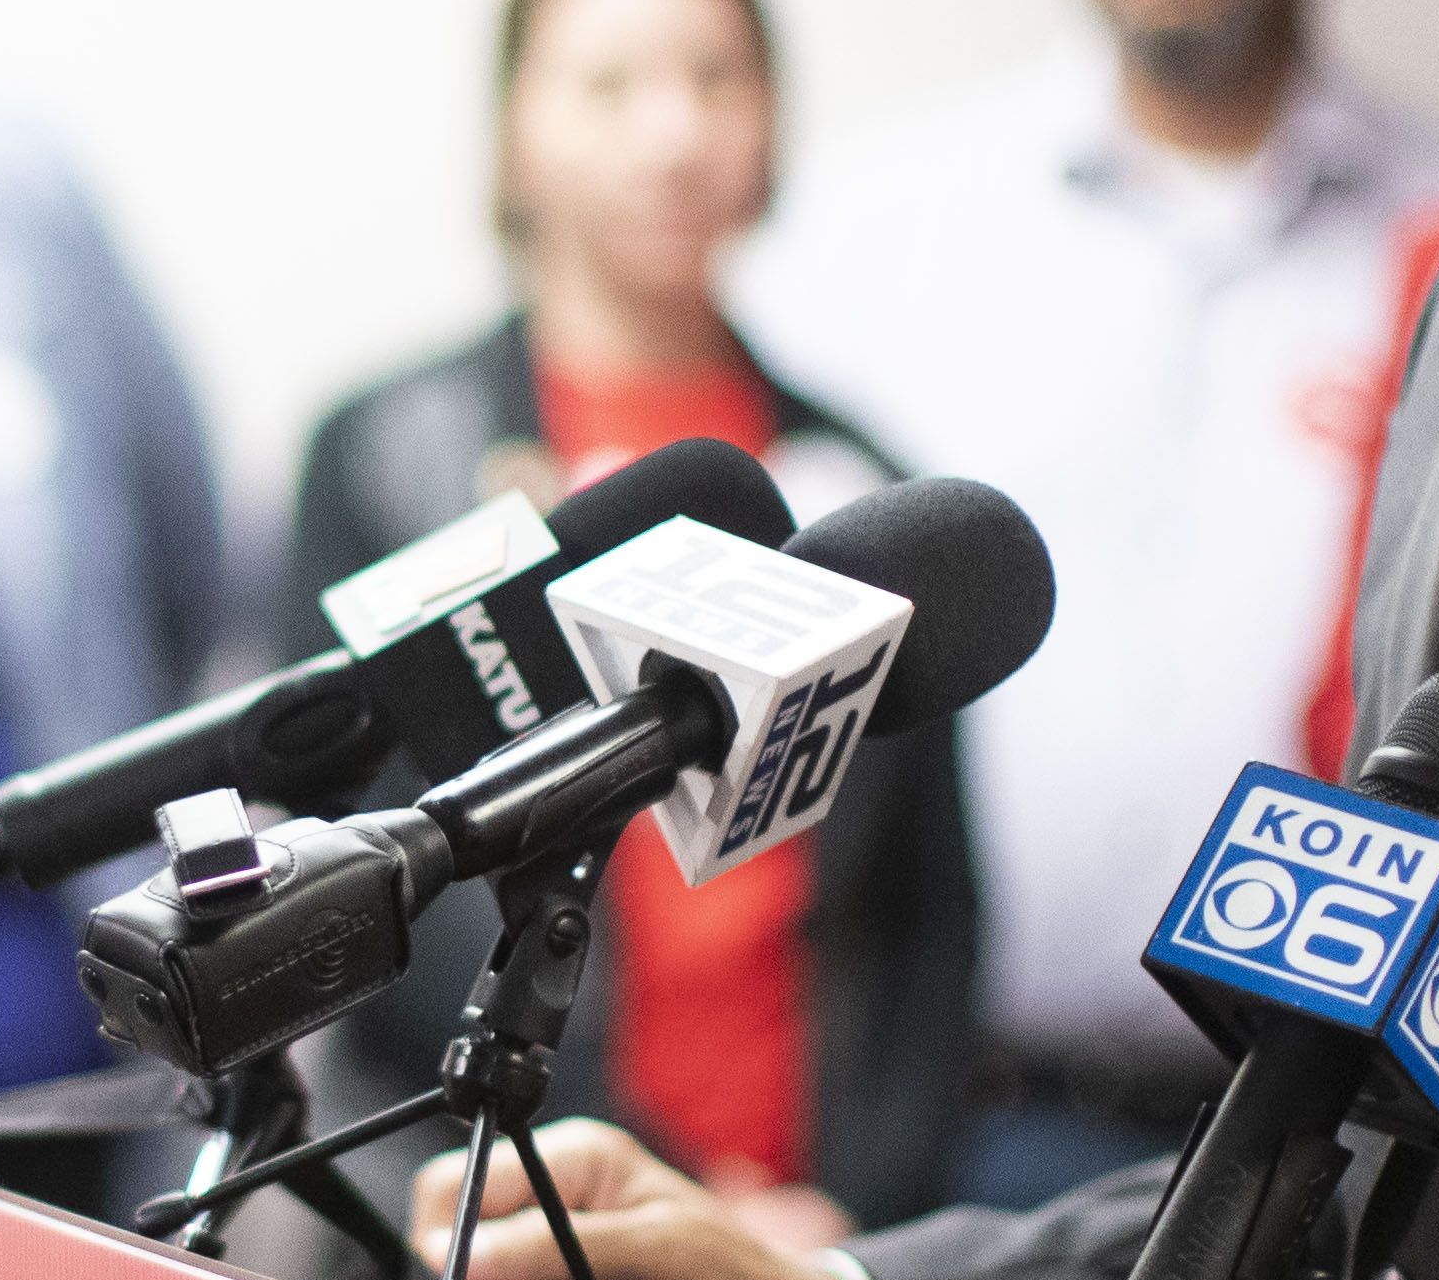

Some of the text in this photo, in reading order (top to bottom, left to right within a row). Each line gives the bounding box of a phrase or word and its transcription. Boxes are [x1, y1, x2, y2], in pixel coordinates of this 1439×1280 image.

[623, 534, 863, 638] 12
[448, 600, 542, 732] KATU
[723, 689, 809, 853] NEWS
[753, 639, 892, 839] 12
[1250, 802, 1426, 885] KOIN
[1283, 883, 1400, 986] 6
